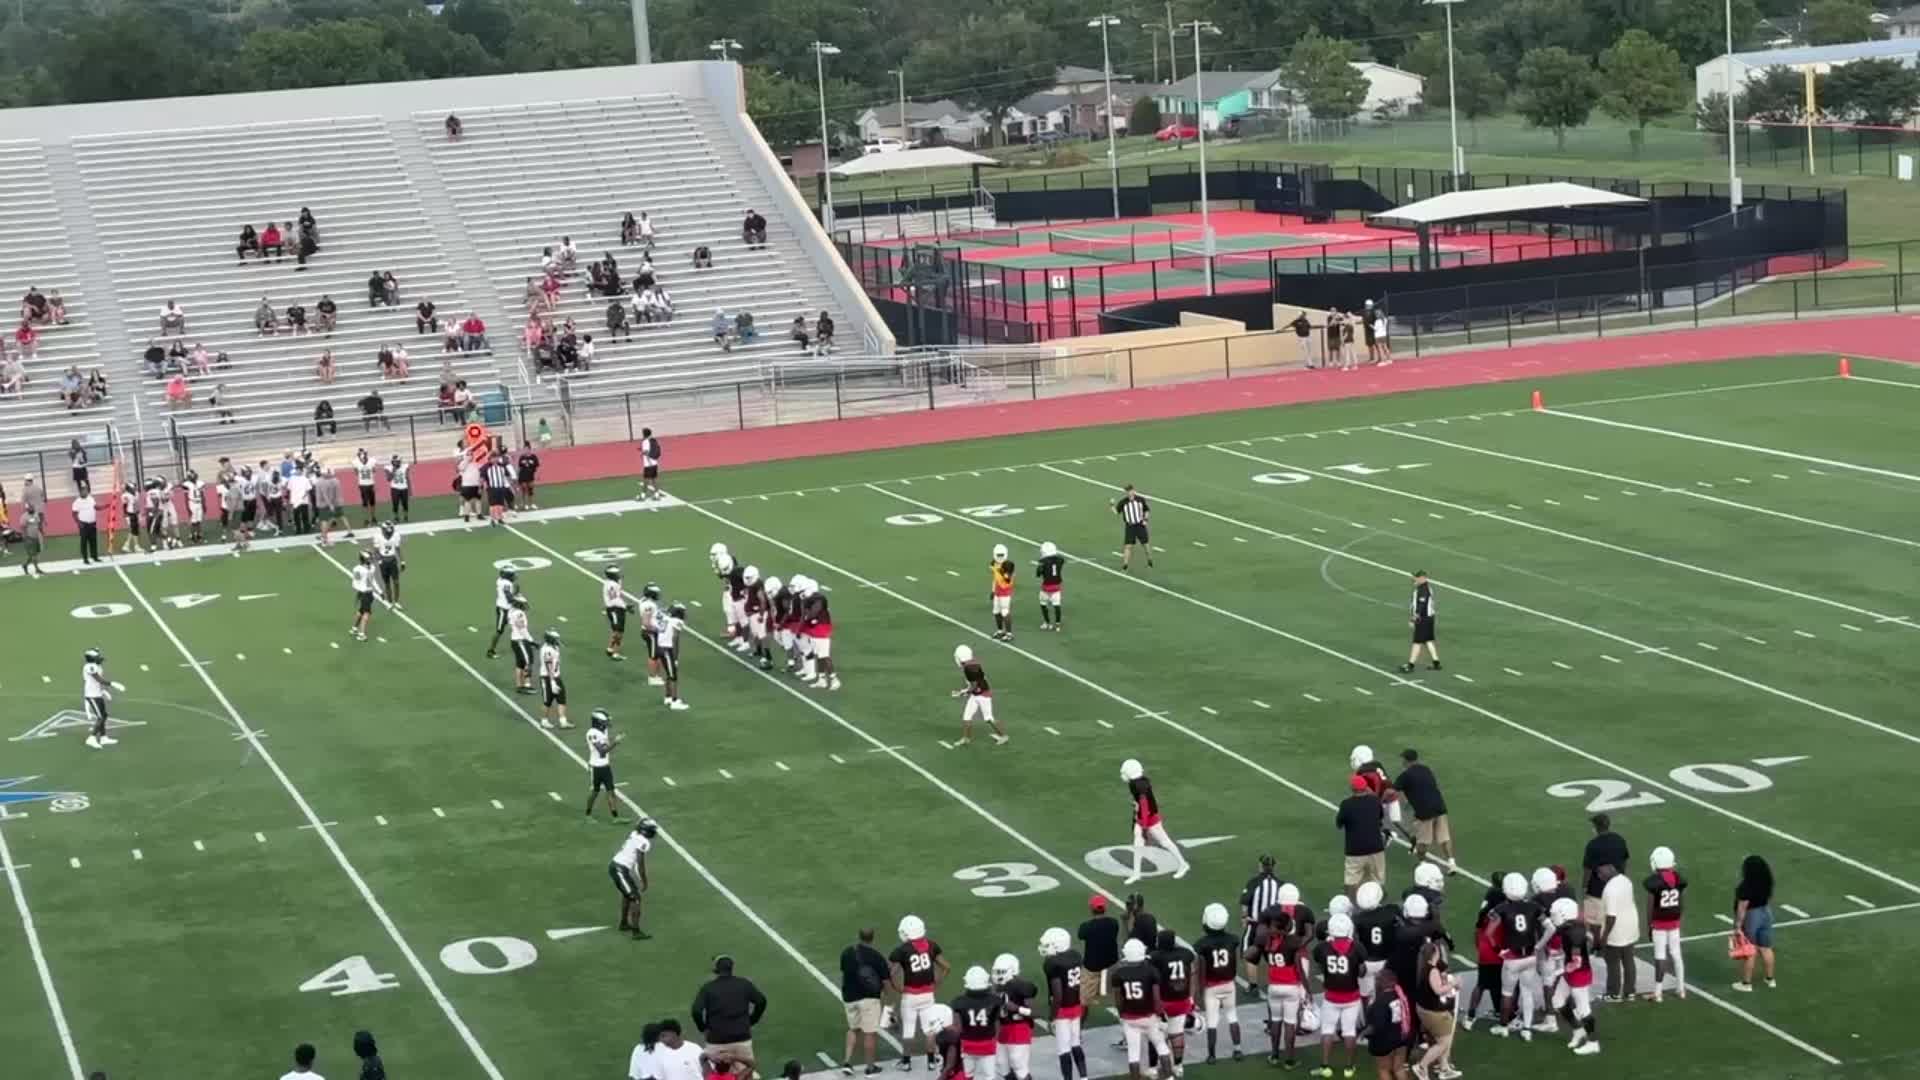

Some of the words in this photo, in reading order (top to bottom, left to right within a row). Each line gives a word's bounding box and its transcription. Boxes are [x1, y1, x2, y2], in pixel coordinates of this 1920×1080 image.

[1051, 563, 1057, 577] 1
[1546, 763, 1773, 812] 20
[1660, 888, 1680, 907] 22
[1514, 914, 1527, 932] 8
[1371, 926, 1383, 944] 6
[299, 936, 538, 996] 40
[909, 952, 932, 973] 28
[1212, 949, 1229, 968] 13
[1326, 955, 1349, 974] 59
[1168, 960, 1186, 980] 71
[1123, 981, 1144, 1000] 15
[967, 1008, 989, 1027] 14
